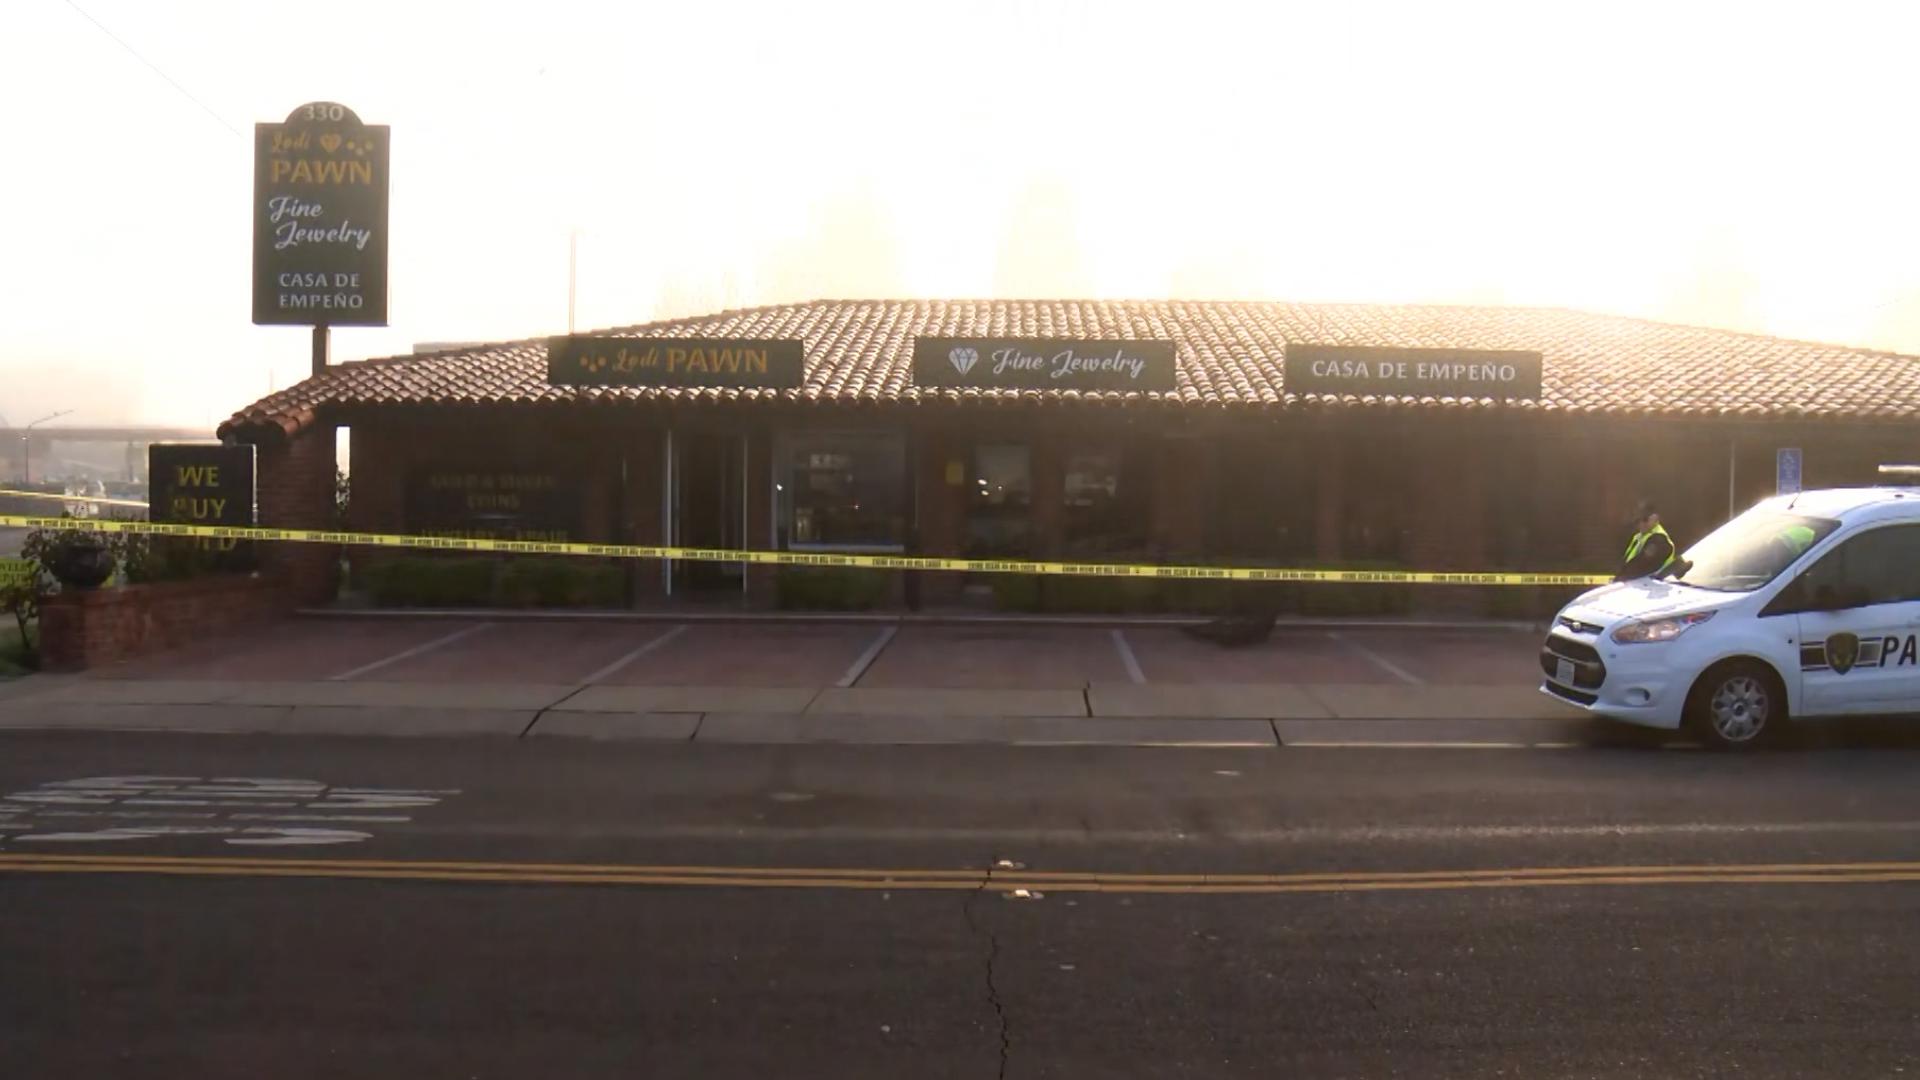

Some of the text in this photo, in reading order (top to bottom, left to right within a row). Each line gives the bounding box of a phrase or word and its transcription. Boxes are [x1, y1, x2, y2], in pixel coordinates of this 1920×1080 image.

[304, 104, 344, 121] 330
[271, 159, 372, 184] PAWN
[268, 196, 323, 223] Fine
[274, 219, 371, 251] Jewelry
[279, 272, 361, 288] CASA DE
[279, 291, 363, 309] EMPEÑO
[612, 347, 769, 374] Lodi PAWN
[991, 348, 1147, 379] Fine Jewelry
[1312, 360, 1517, 382] CASA DE EMPEÑO
[177, 466, 220, 488] WE
